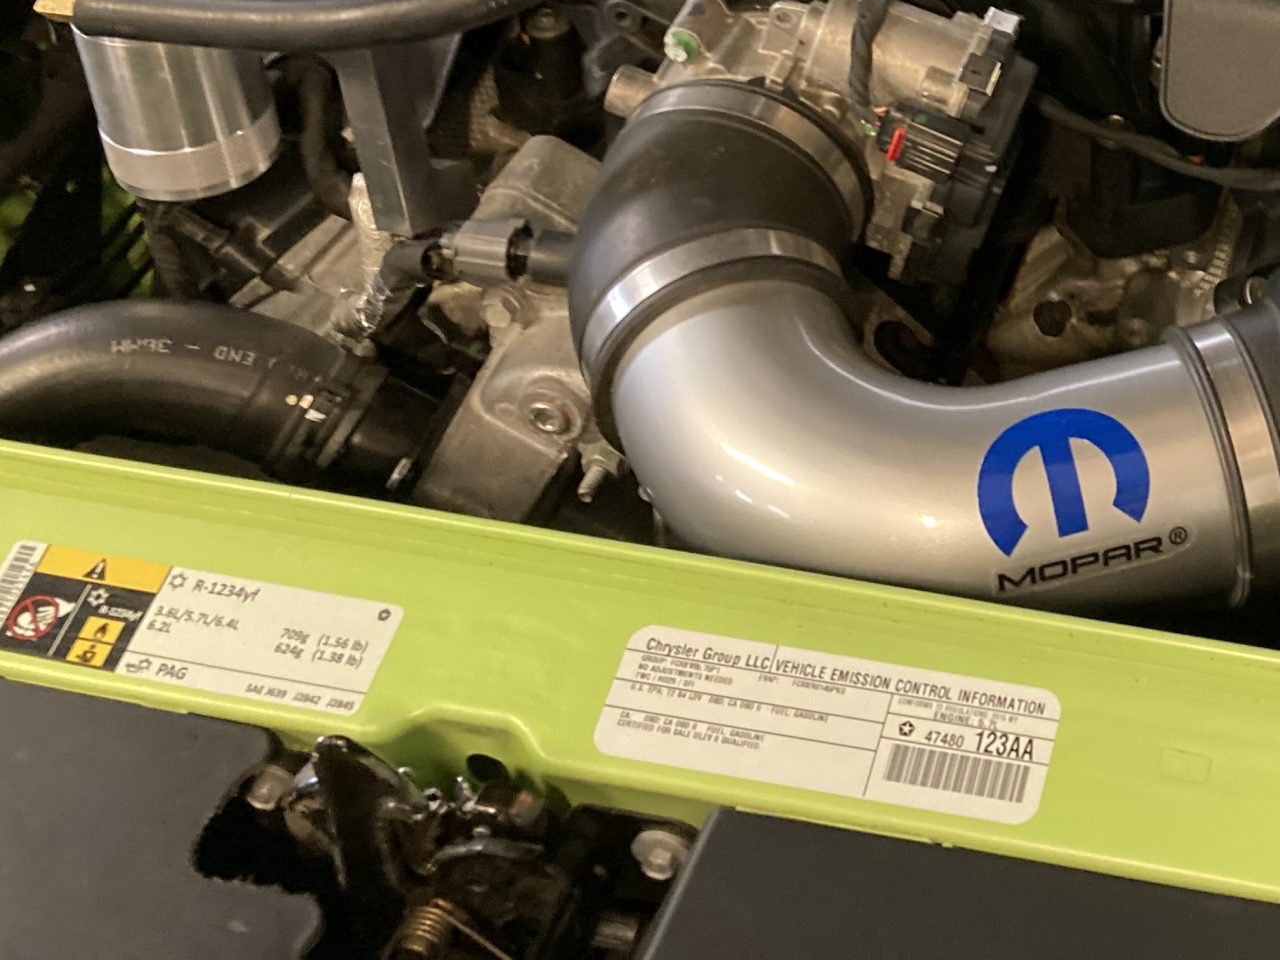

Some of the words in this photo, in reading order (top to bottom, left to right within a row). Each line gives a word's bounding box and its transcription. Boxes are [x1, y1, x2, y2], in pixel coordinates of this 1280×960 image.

[214, 345, 256, 366] END
[997, 537, 1164, 593] MOPAR
[192, 579, 261, 603] R-1234yf
[280, 628, 310, 644] 709g
[274, 643, 304, 659] 624g
[646, 637, 699, 659] Chrysler
[703, 647, 741, 667] Group
[745, 654, 770, 671] LLC
[156, 663, 188, 680] PAG
[775, 659, 826, 680] VEHICLE
[830, 668, 892, 690] EMISSION
[895, 679, 952, 701] CONTROL
[958, 689, 1046, 716] INFORMATION
[924, 730, 965, 748] 47480
[975, 731, 1035, 761] 123AA
